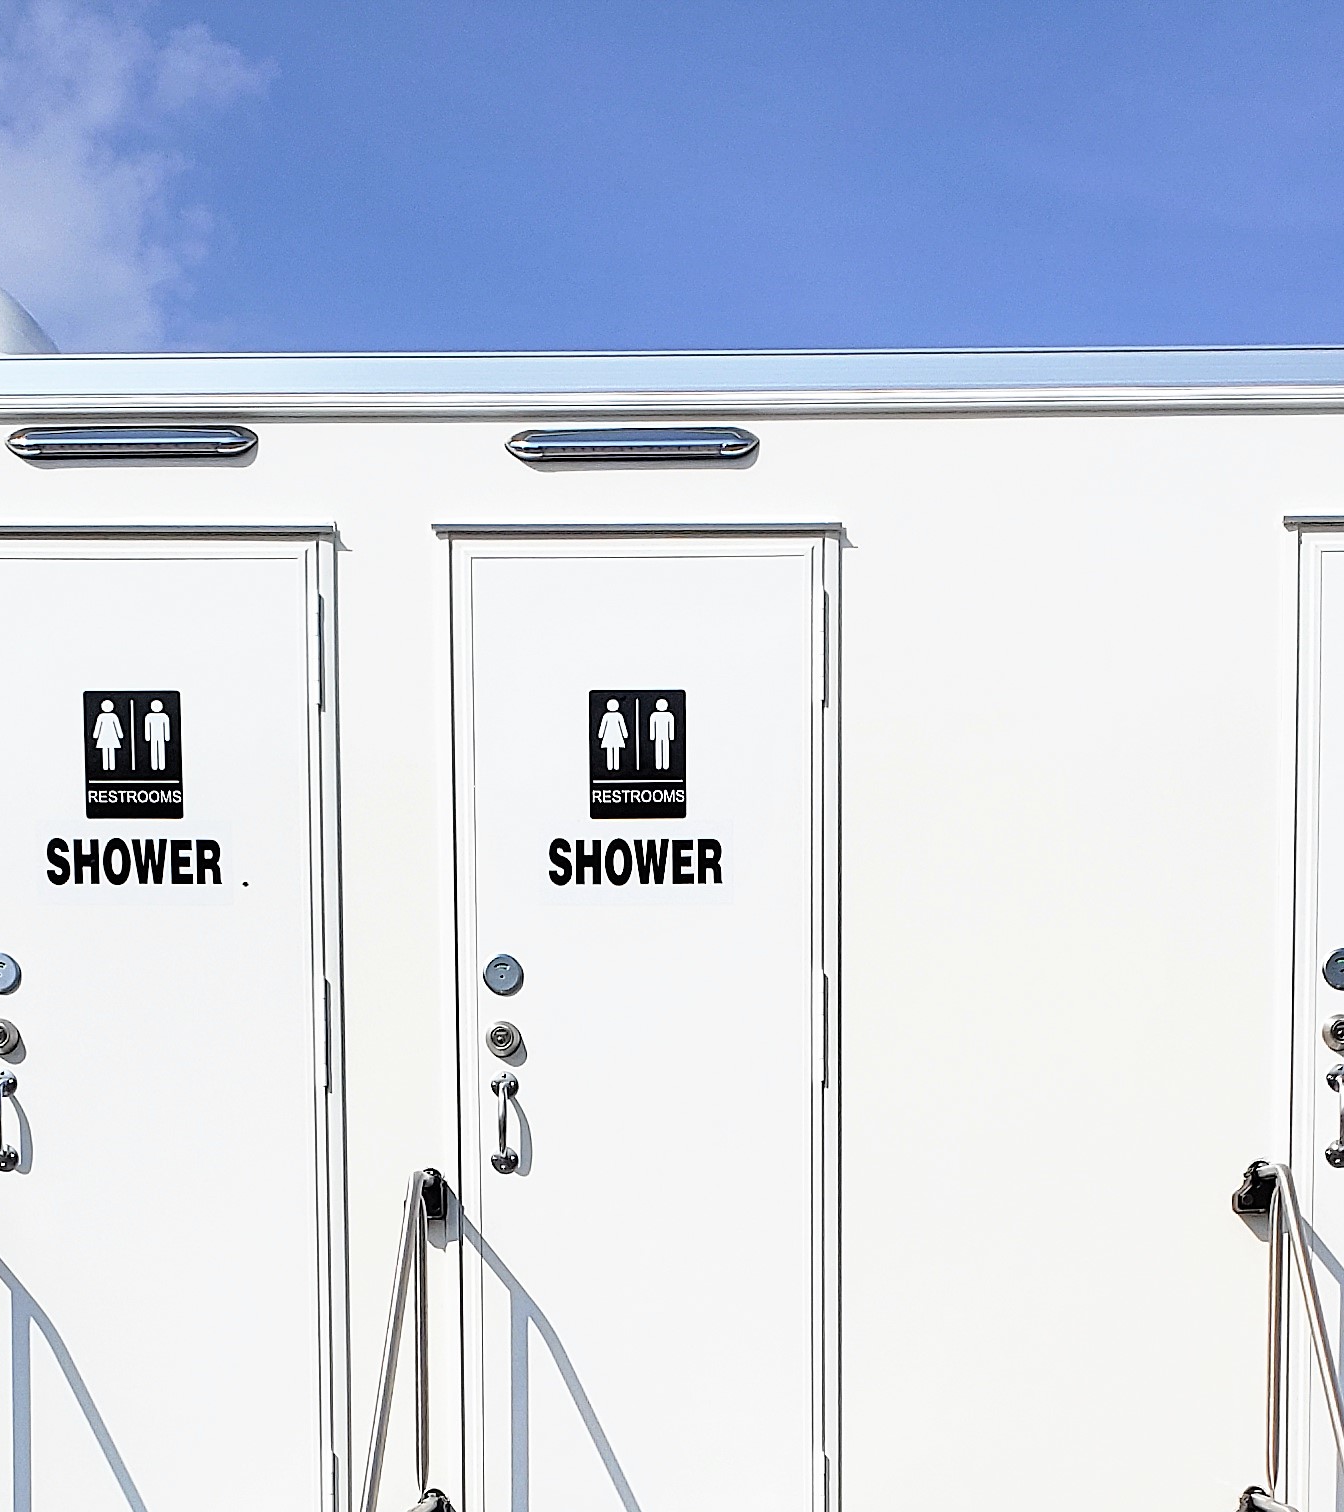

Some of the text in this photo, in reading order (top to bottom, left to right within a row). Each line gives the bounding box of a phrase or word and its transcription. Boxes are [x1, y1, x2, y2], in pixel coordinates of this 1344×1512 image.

[88, 790, 182, 804] RESTROOMS
[592, 790, 685, 803] RESTROOMS
[46, 837, 223, 886] SHOWER
[548, 837, 723, 887] SHOWER
